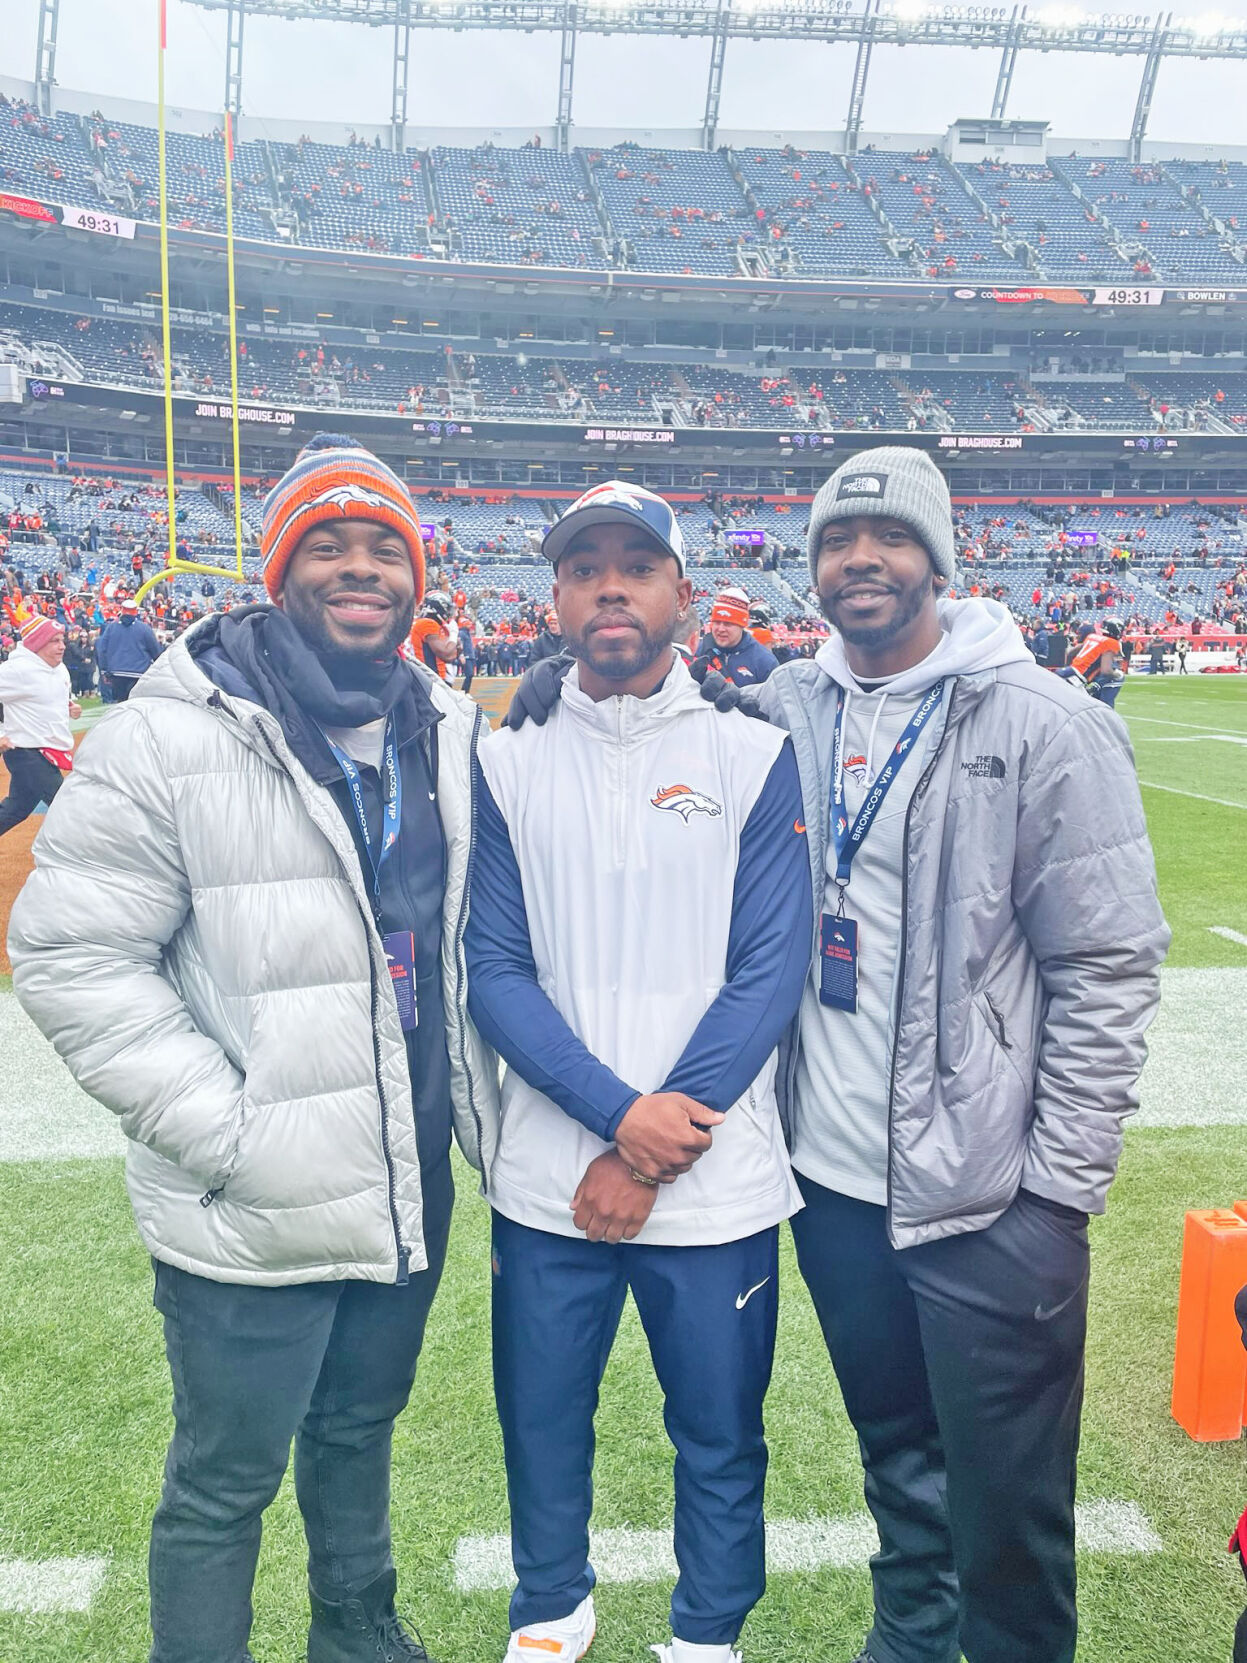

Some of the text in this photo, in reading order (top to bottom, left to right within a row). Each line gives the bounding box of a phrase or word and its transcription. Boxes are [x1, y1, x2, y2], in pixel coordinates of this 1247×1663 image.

[77, 214, 120, 235] 49:31
[981, 291, 1032, 299] COUNTDOWN
[1033, 292, 1044, 300] TO
[1108, 290, 1150, 304] 49:31
[1187, 292, 1226, 301] BOWLEN
[195, 404, 296, 425] JOIN BRGHOUSE.COM
[585, 429, 675, 442] JOIN BRAGHOUSE.COM
[938, 437, 1023, 449] JOIN BRAGHOUSE.COM
[960, 762, 990, 770] NORTH
[976, 755, 992, 763] THE
[386, 744, 398, 820] BRONCOS VIP
[342, 759, 371, 845] BRONCOS VIP
[852, 766, 893, 841] BRONCOS VIP
